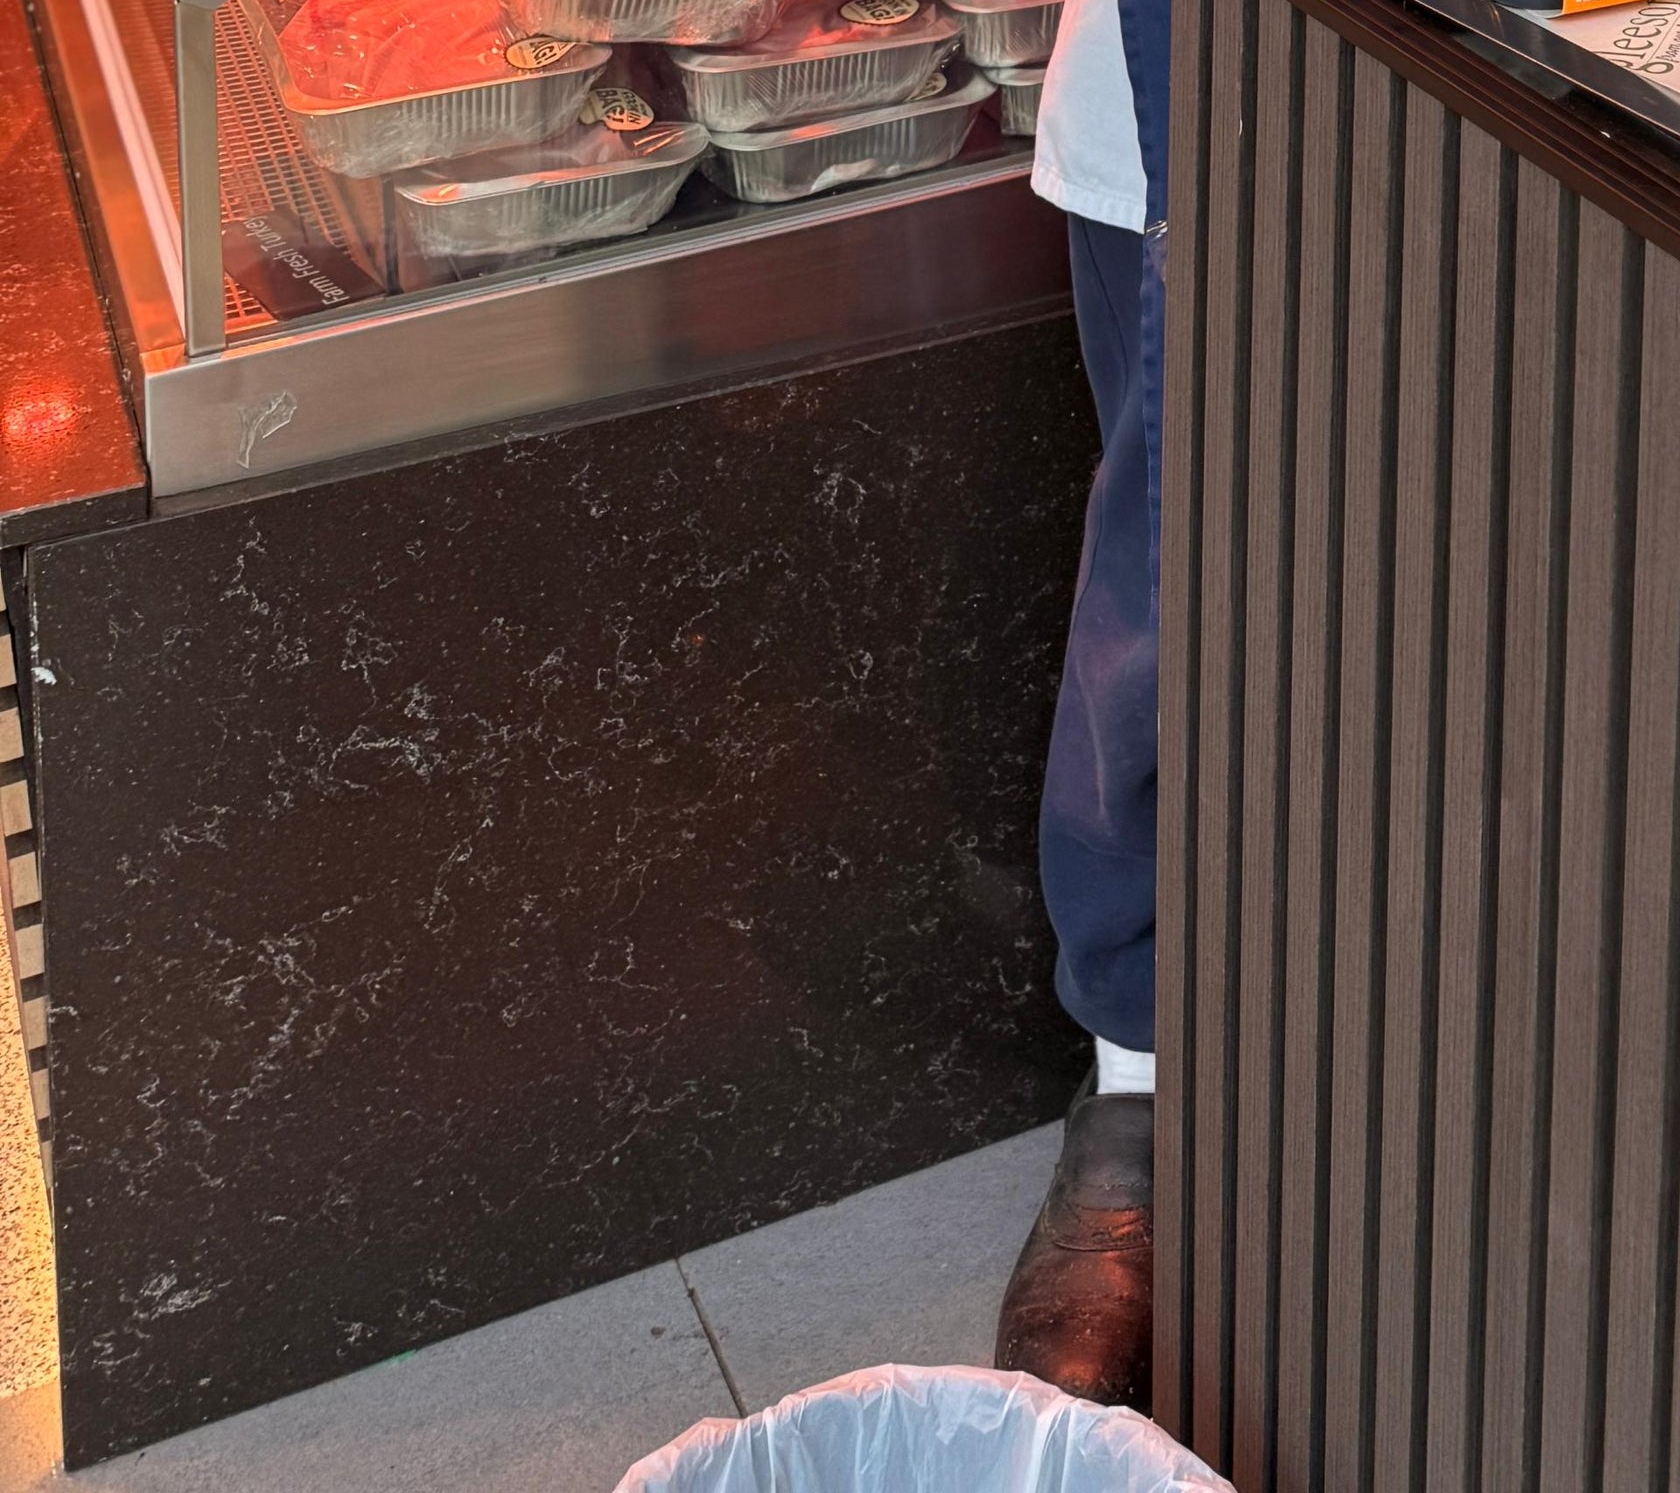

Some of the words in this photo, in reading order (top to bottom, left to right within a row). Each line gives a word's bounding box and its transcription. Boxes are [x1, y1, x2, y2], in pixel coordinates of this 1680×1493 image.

[529, 40, 557, 65] AG!
[244, 215, 286, 252] Turkey
[273, 248, 319, 279] Fresh
[309, 275, 350, 305] Farm
